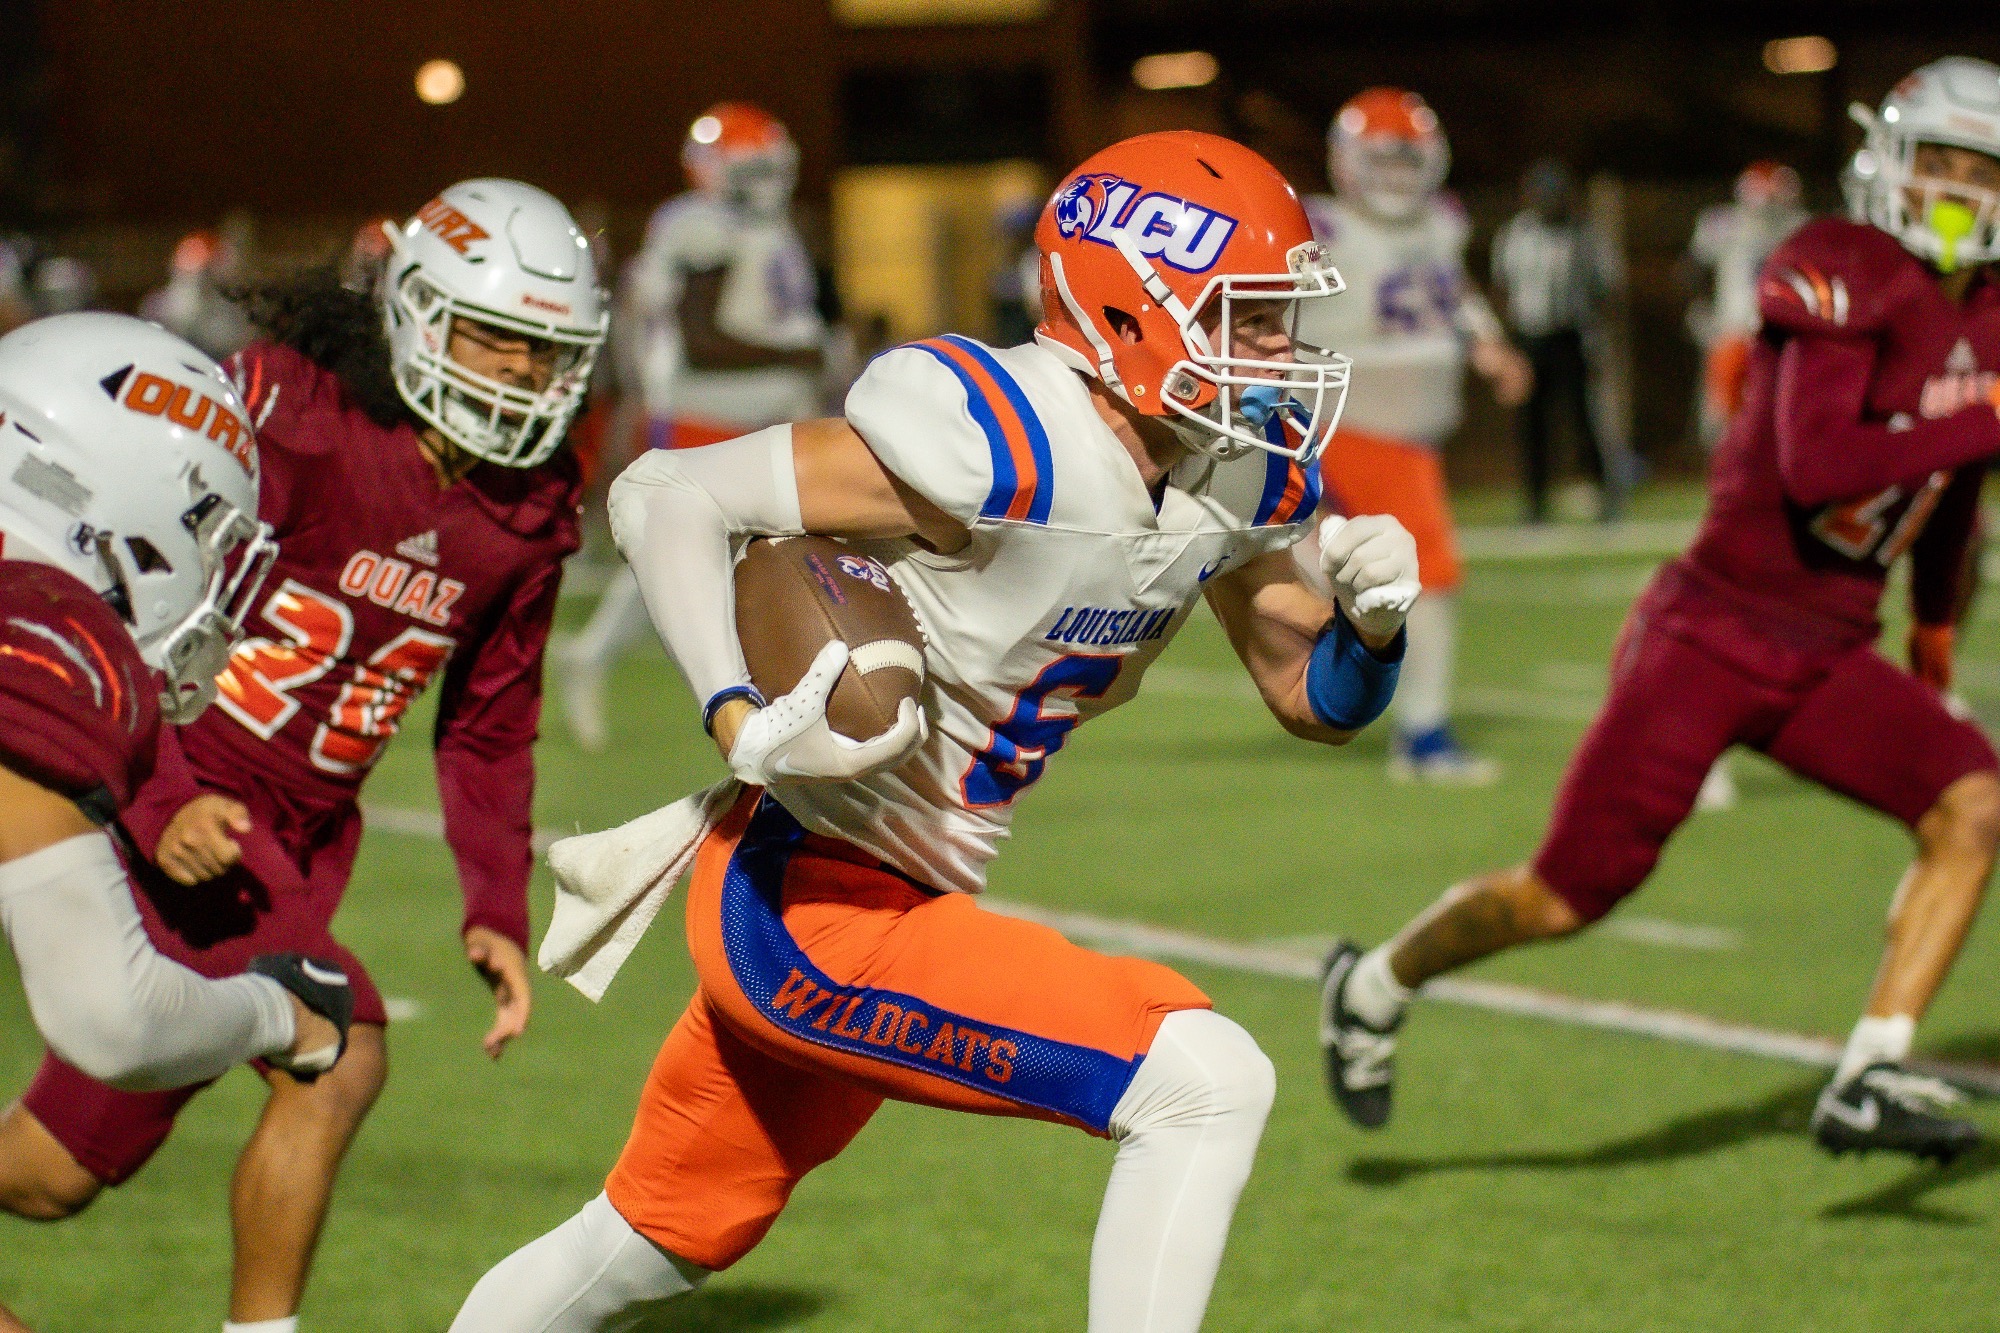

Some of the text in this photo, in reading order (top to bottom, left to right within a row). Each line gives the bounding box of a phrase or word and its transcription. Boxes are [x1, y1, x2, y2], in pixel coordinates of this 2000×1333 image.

[1081, 179, 1239, 274] LCU
[339, 549, 467, 628] OUAZ
[1044, 606, 1176, 645] LOUISIANA
[959, 652, 1125, 809] 6
[772, 967, 1017, 1084] WILDCATS
